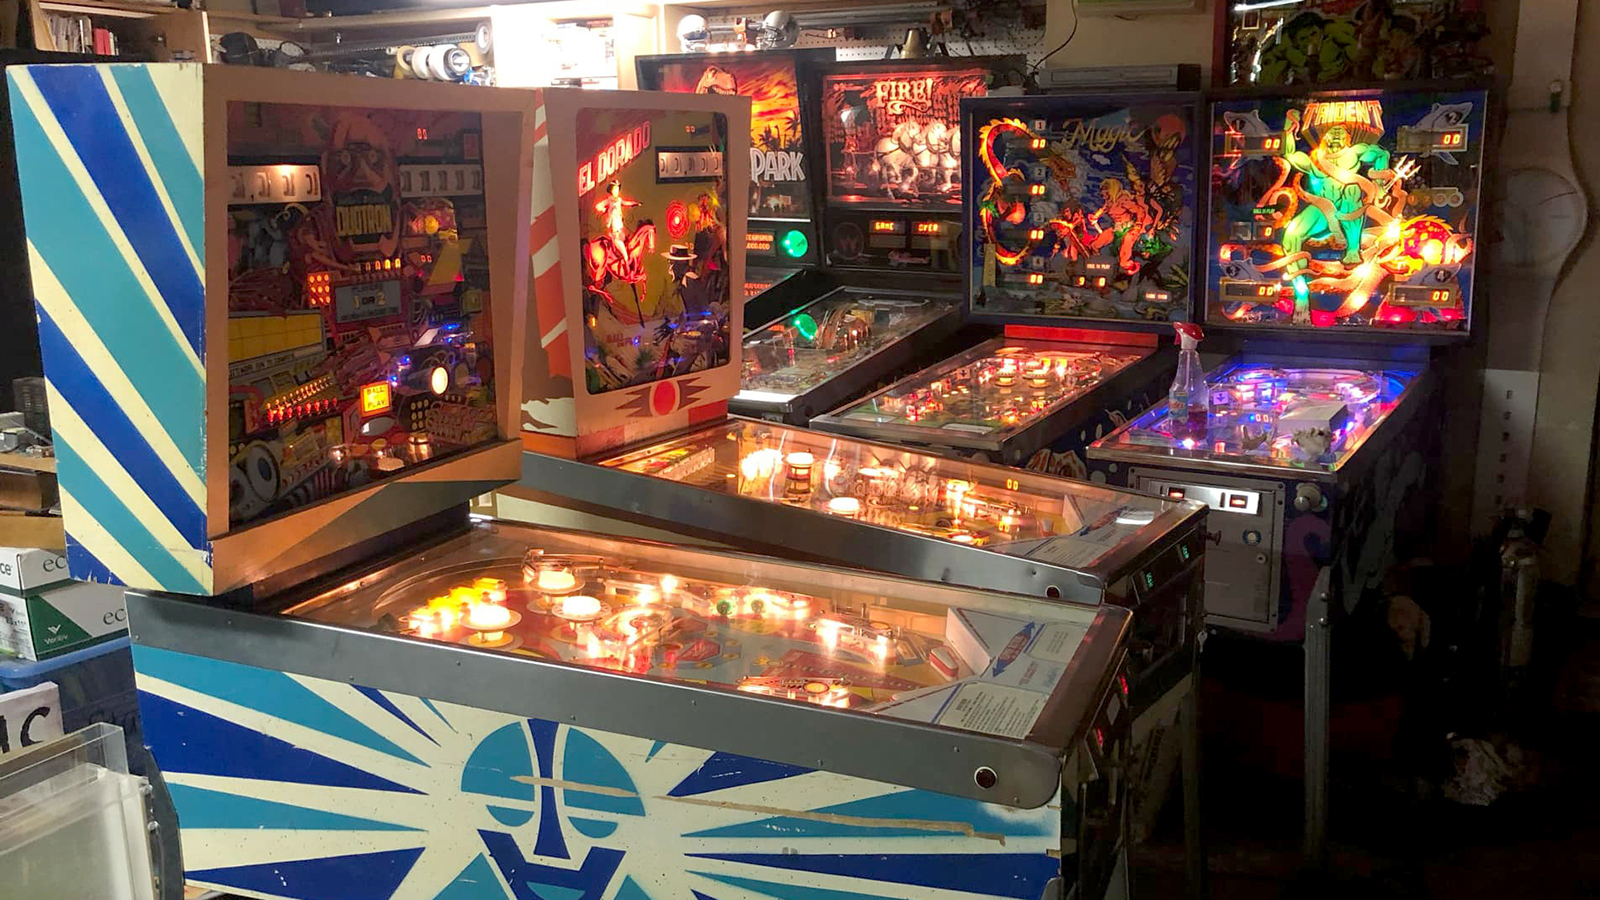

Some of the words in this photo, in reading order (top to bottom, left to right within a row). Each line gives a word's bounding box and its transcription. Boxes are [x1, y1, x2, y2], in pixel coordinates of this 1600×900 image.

[874, 78, 934, 111] FIRE!
[1301, 100, 1384, 131] TRIDENT
[1062, 117, 1151, 153] Magic
[1443, 134, 1460, 145] 00
[1033, 139, 1046, 148] 00
[1265, 138, 1280, 149] 00
[578, 162, 595, 197] EL
[597, 120, 650, 184] DORADO
[750, 147, 806, 183] PARK
[1032, 185, 1045, 195] 00
[1264, 227, 1272, 236] 0
[1258, 286, 1273, 296] 00
[1432, 290, 1449, 301] 00
[366, 386, 386, 396] BALL
[367, 398, 386, 409] PLAY
